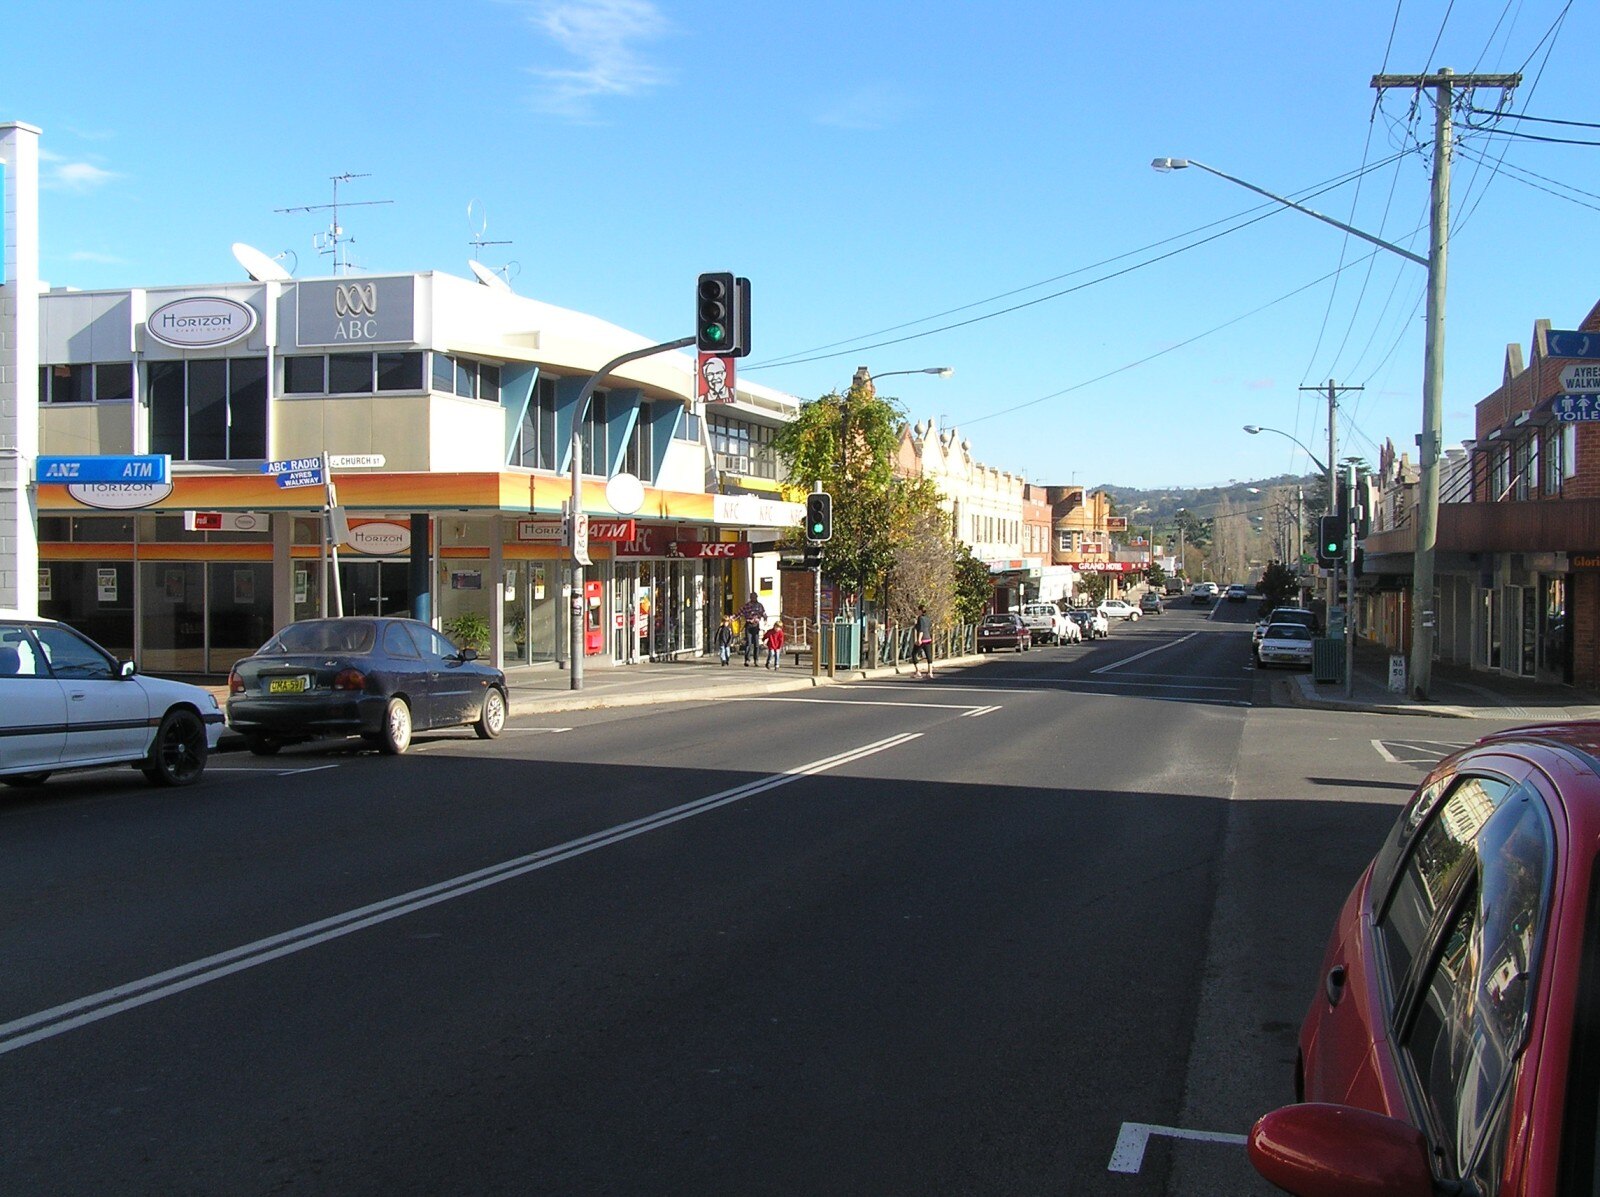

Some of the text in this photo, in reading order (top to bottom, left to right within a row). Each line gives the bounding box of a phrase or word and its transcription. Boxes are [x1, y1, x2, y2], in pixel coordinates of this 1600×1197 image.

[163, 313, 232, 328] HORIZON
[334, 319, 378, 340] ABC
[1566, 378, 1600, 389] WALKW
[1555, 411, 1600, 420] TOILE
[268, 461, 287, 473] ABC
[290, 458, 319, 470] RADIO
[340, 457, 371, 465] CHURCH
[46, 462, 152, 477] ANZ ATM
[289, 471, 312, 480] AYRES
[284, 477, 319, 487] WALKWAY
[524, 524, 562, 535] HORIZ
[588, 523, 627, 537] ATM
[355, 532, 403, 542] HORIZON
[699, 543, 736, 556] KFC
[1078, 562, 1104, 570] GRAND
[1105, 562, 1123, 570] HOTEL
[1573, 556, 1600, 568] Glori
